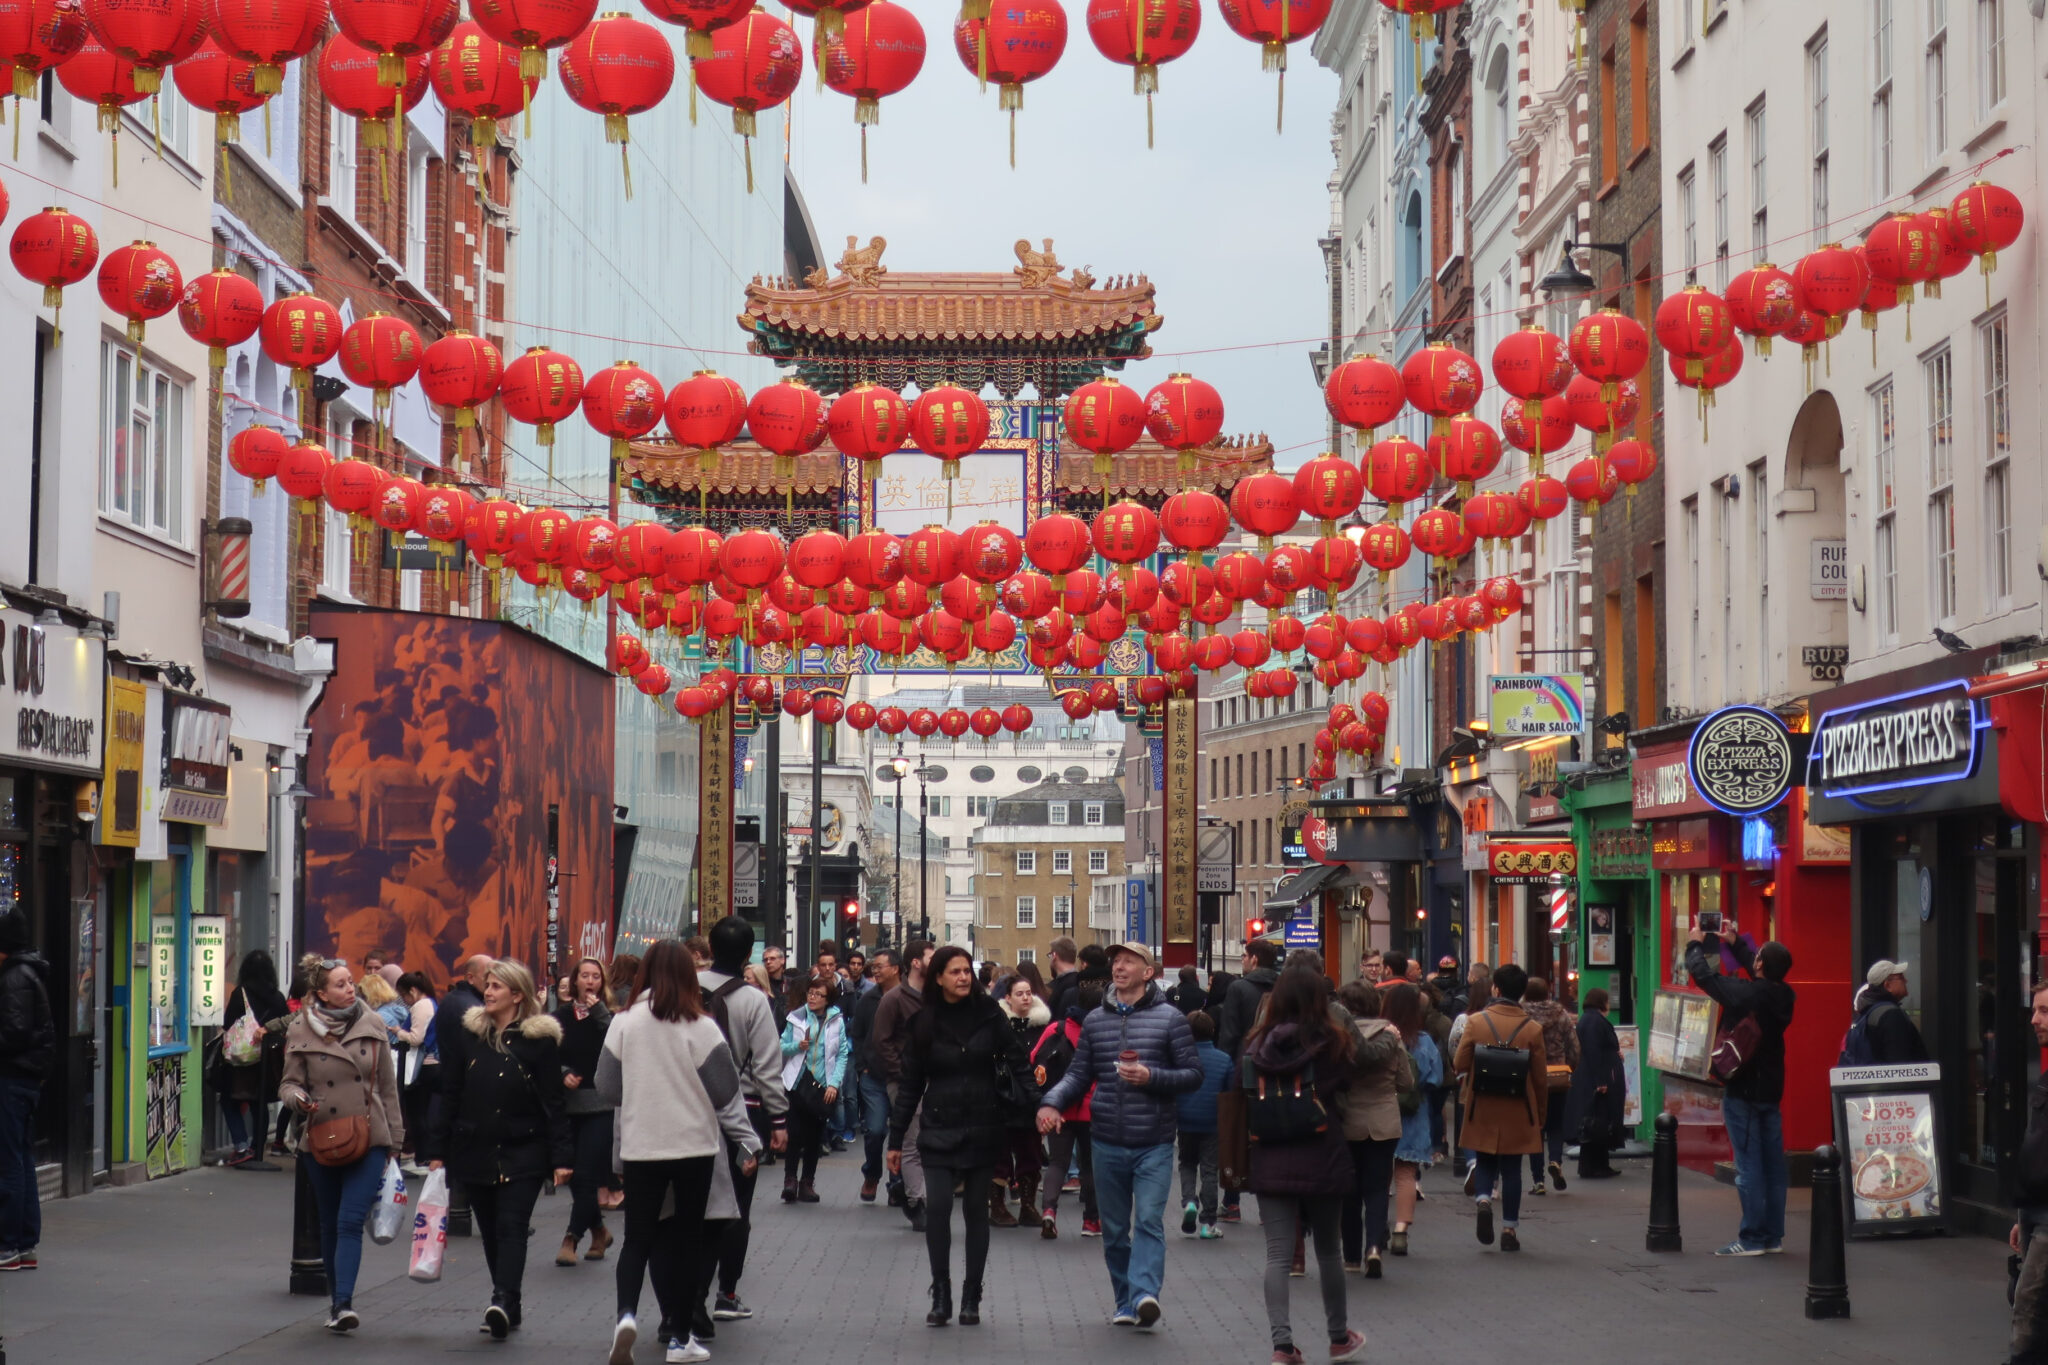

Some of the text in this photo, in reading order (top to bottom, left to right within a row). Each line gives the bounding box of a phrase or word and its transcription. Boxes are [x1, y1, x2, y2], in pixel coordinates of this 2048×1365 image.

[330, 57, 378, 72] Shaftesb
[1812, 665, 1845, 679] CO
[1495, 679, 1543, 690] RAINBOW
[1521, 721, 1580, 732] HAIR SALON
[1720, 746, 1767, 758] PIZZA
[1707, 758, 1780, 770] EXPRESS
[1497, 852, 1571, 872] 文興酒家
[1199, 881, 1228, 889] ENDS
[1494, 876, 1524, 884] CHINESE
[734, 896, 754, 904] NDS
[198, 925, 220, 935] MEN &
[195, 937, 222, 946] WOMEN
[203, 949, 214, 1008] CUTS
[1842, 1067, 1928, 1080] PIZZAEXPRESS
[1864, 1131, 1915, 1146] £13.95
